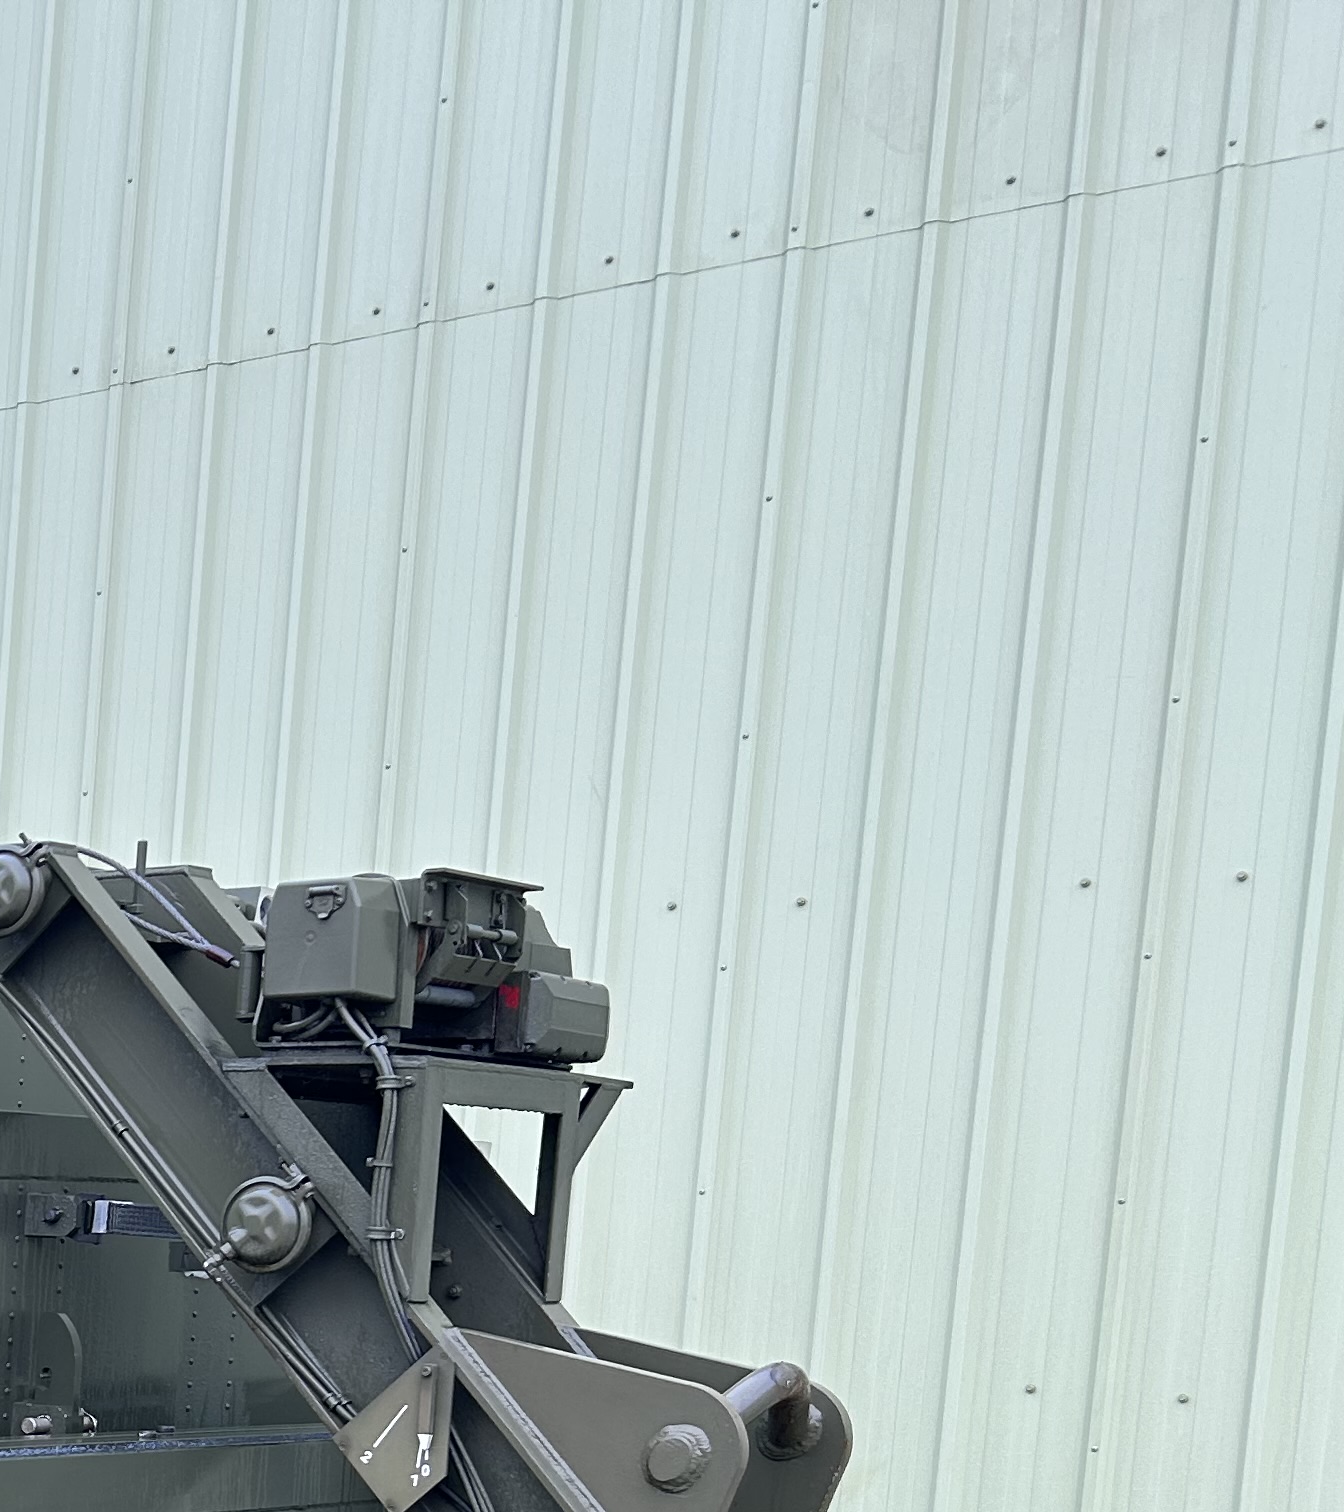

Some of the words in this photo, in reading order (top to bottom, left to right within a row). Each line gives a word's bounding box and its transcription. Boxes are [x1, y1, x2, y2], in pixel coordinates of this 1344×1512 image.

[359, 1450, 373, 1465] 2
[420, 1463, 431, 1477] 0
[410, 1473, 419, 1488] 1
